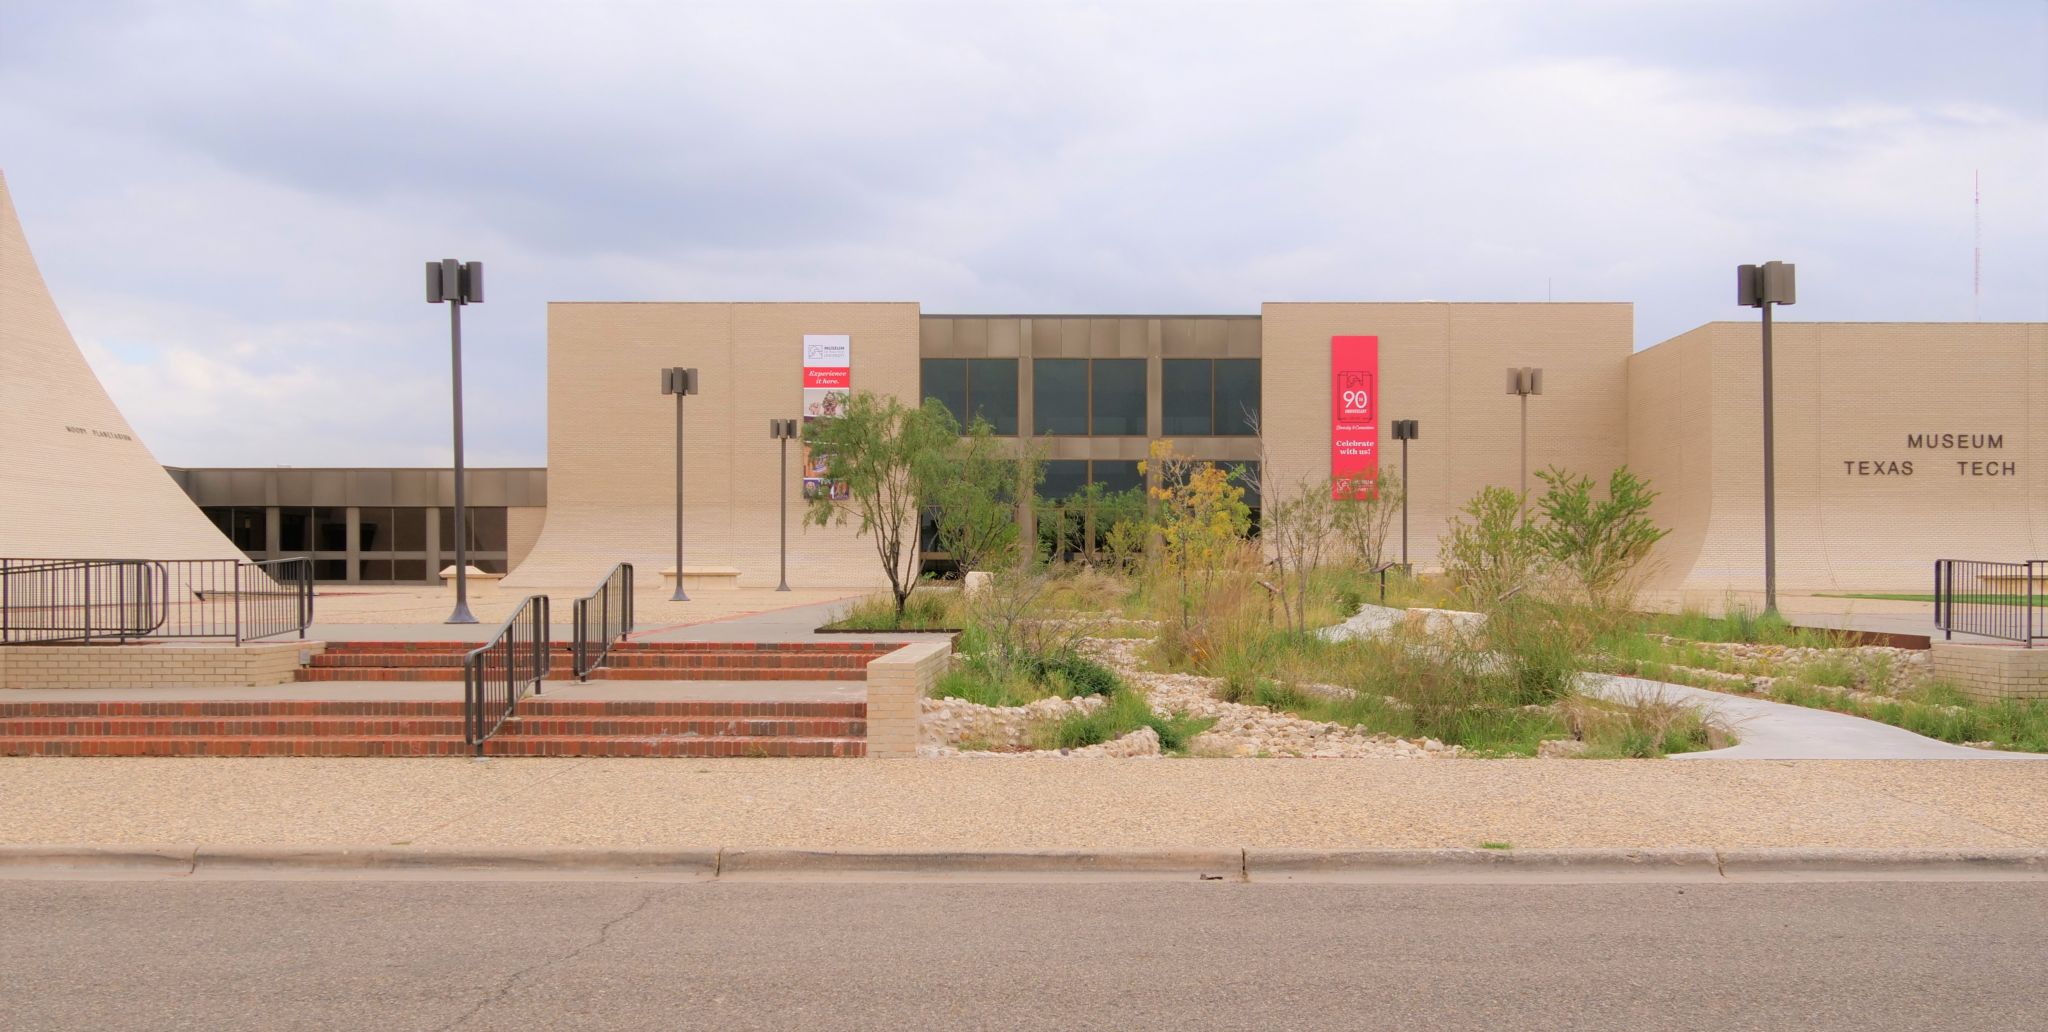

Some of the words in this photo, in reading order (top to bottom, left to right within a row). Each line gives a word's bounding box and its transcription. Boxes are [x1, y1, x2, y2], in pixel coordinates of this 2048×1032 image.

[1343, 391, 1367, 409] 90
[1907, 433, 2003, 449] MUSEUM
[1844, 460, 1913, 476] TEXAS
[1957, 461, 2016, 476] TECH
